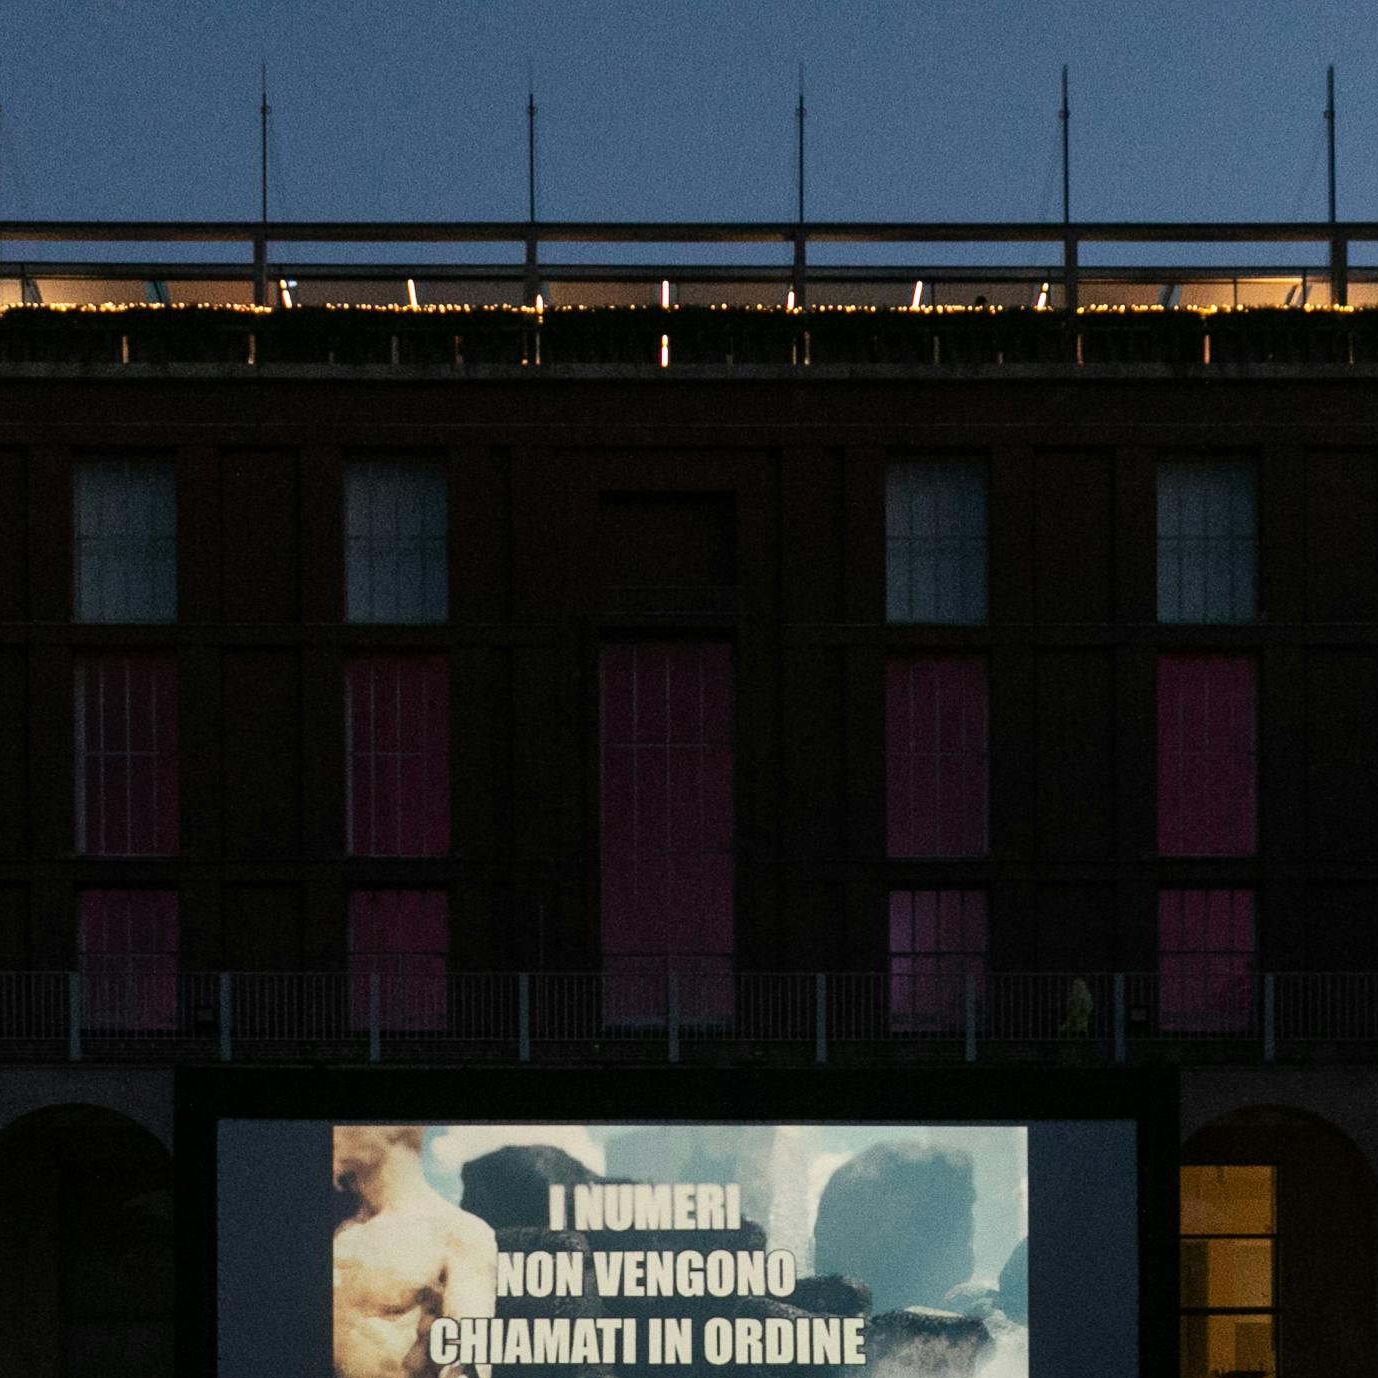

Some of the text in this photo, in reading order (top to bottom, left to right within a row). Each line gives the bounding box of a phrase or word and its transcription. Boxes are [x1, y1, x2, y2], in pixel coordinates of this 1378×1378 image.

[549, 1184, 740, 1230] I NUMERI
[496, 1250, 796, 1297] NON VENGONO
[430, 1317, 866, 1365] CHIAMATI IN ORDINE
